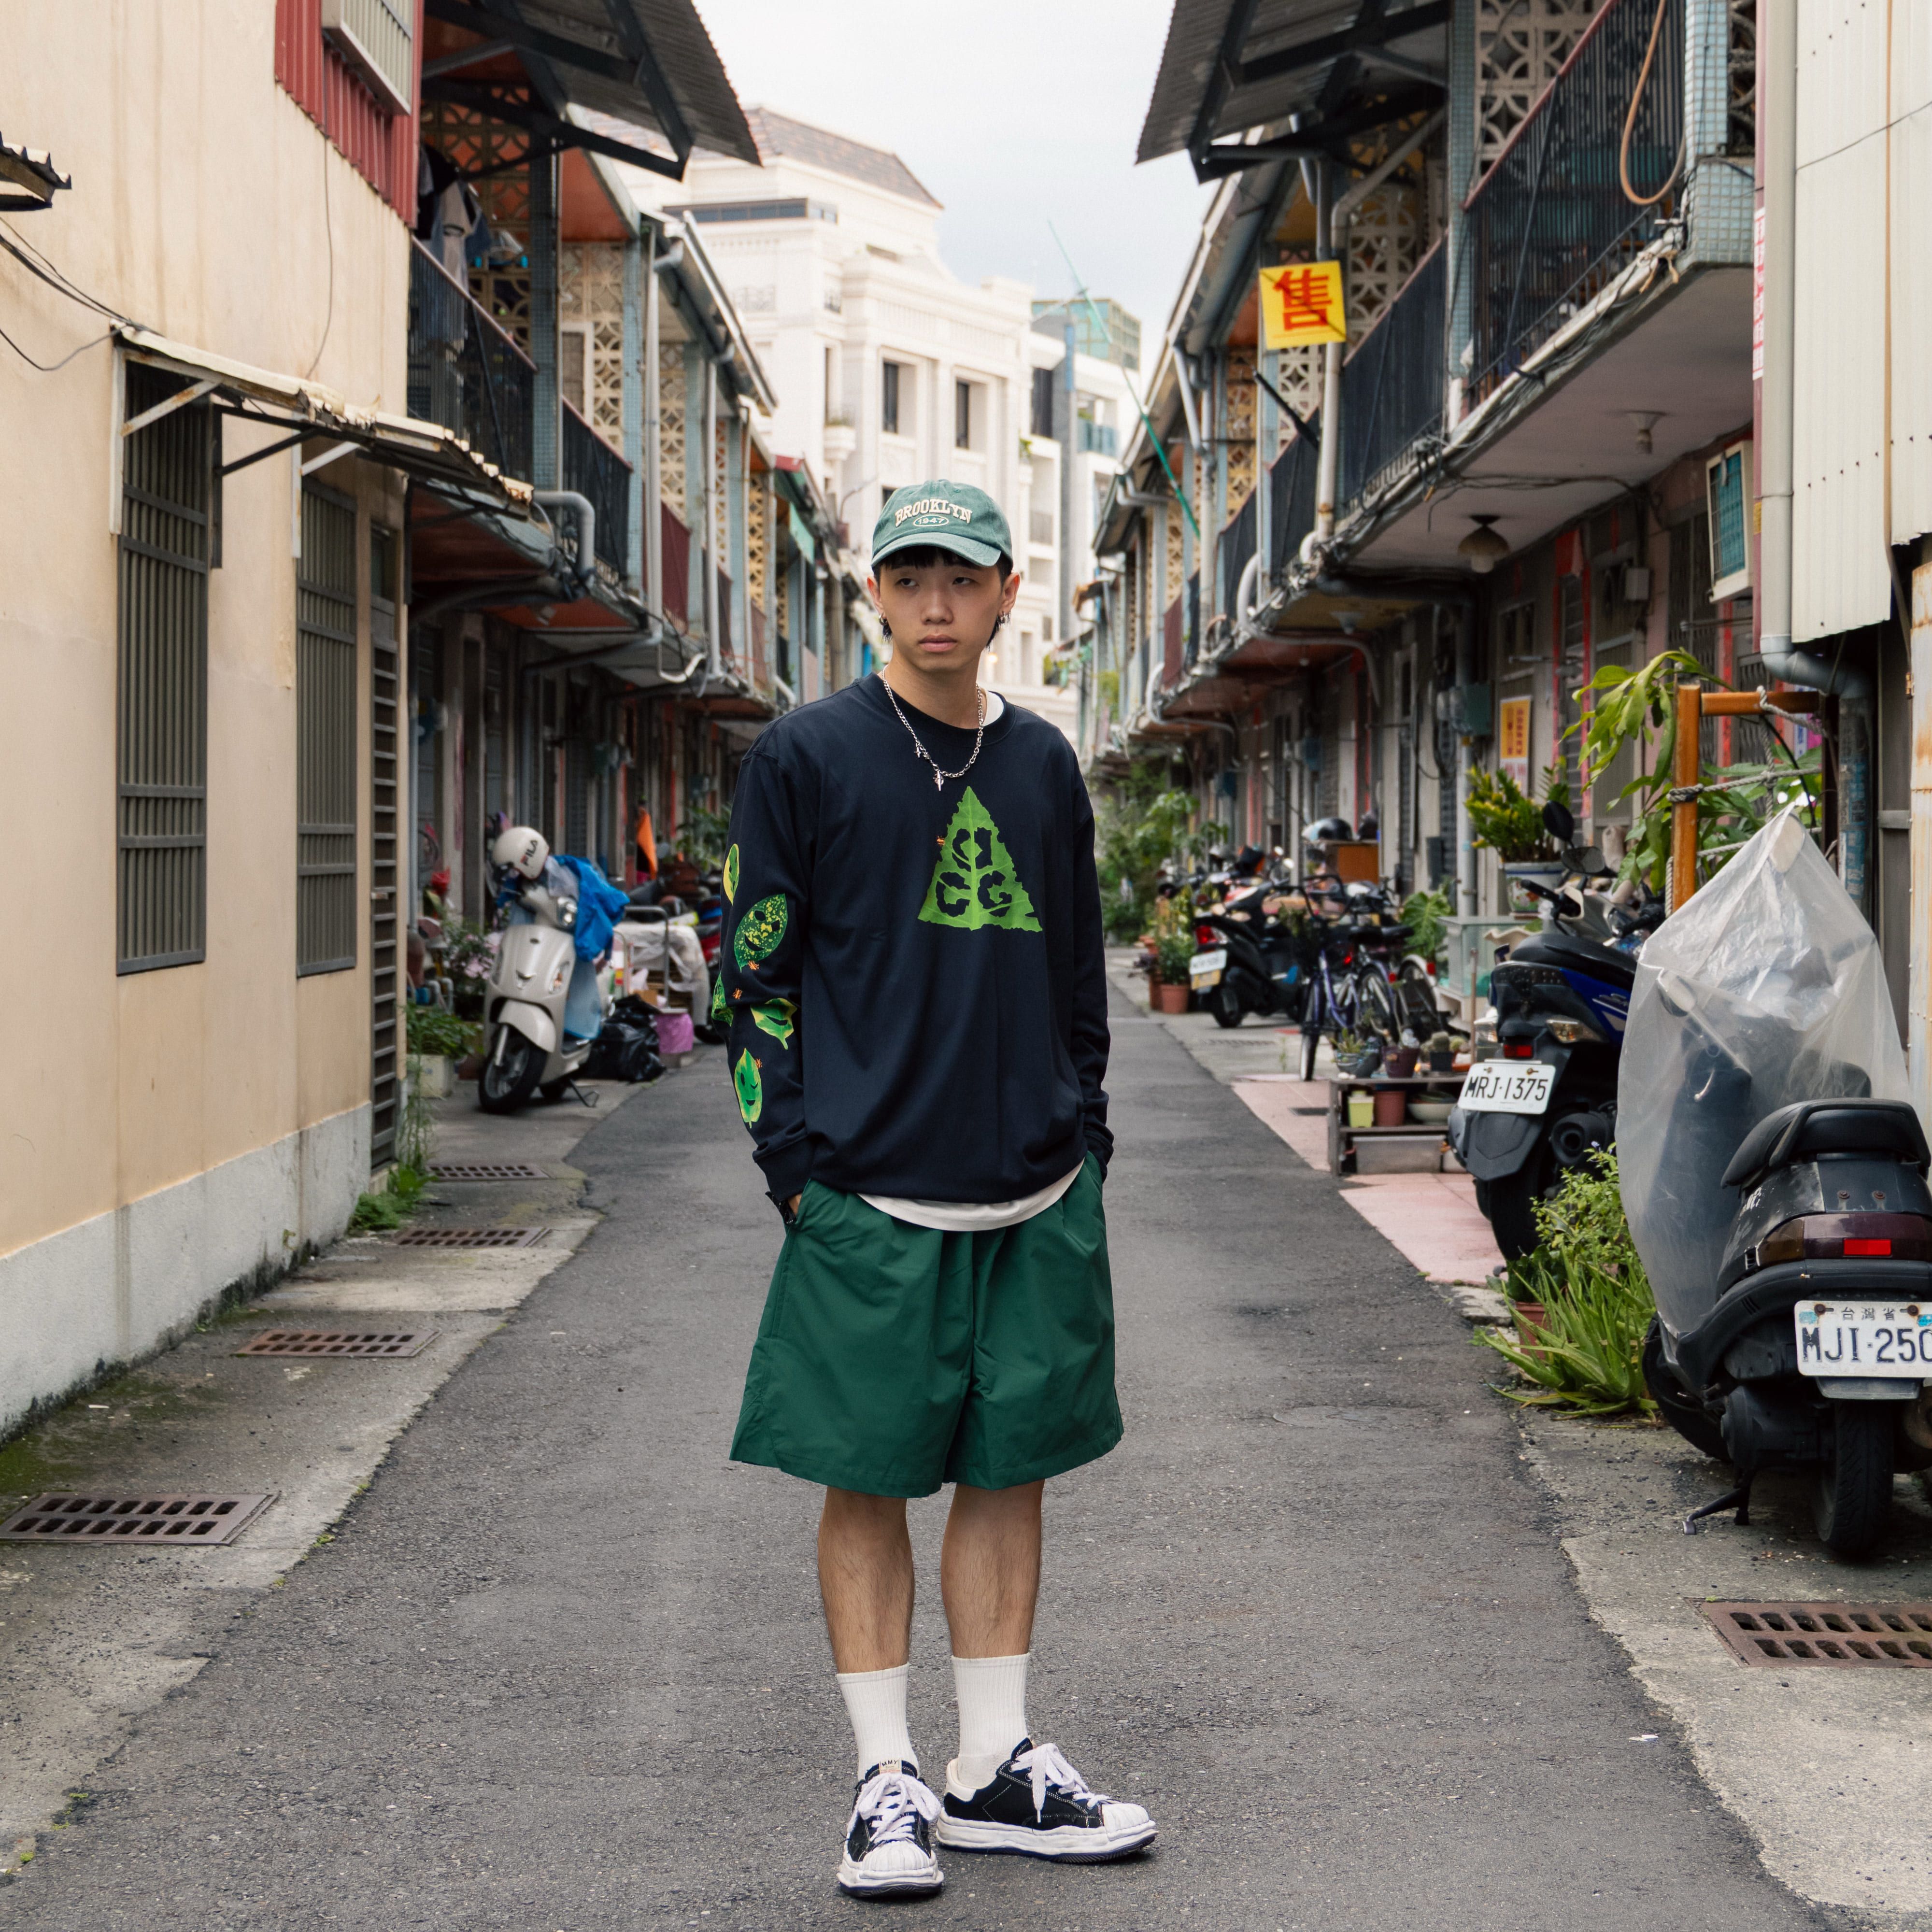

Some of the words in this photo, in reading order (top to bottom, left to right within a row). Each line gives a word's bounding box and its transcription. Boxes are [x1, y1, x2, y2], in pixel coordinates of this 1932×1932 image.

[1273, 268, 1333, 331] 售
[895, 498, 973, 527] BROOKLYN
[520, 840, 539, 866] FILA
